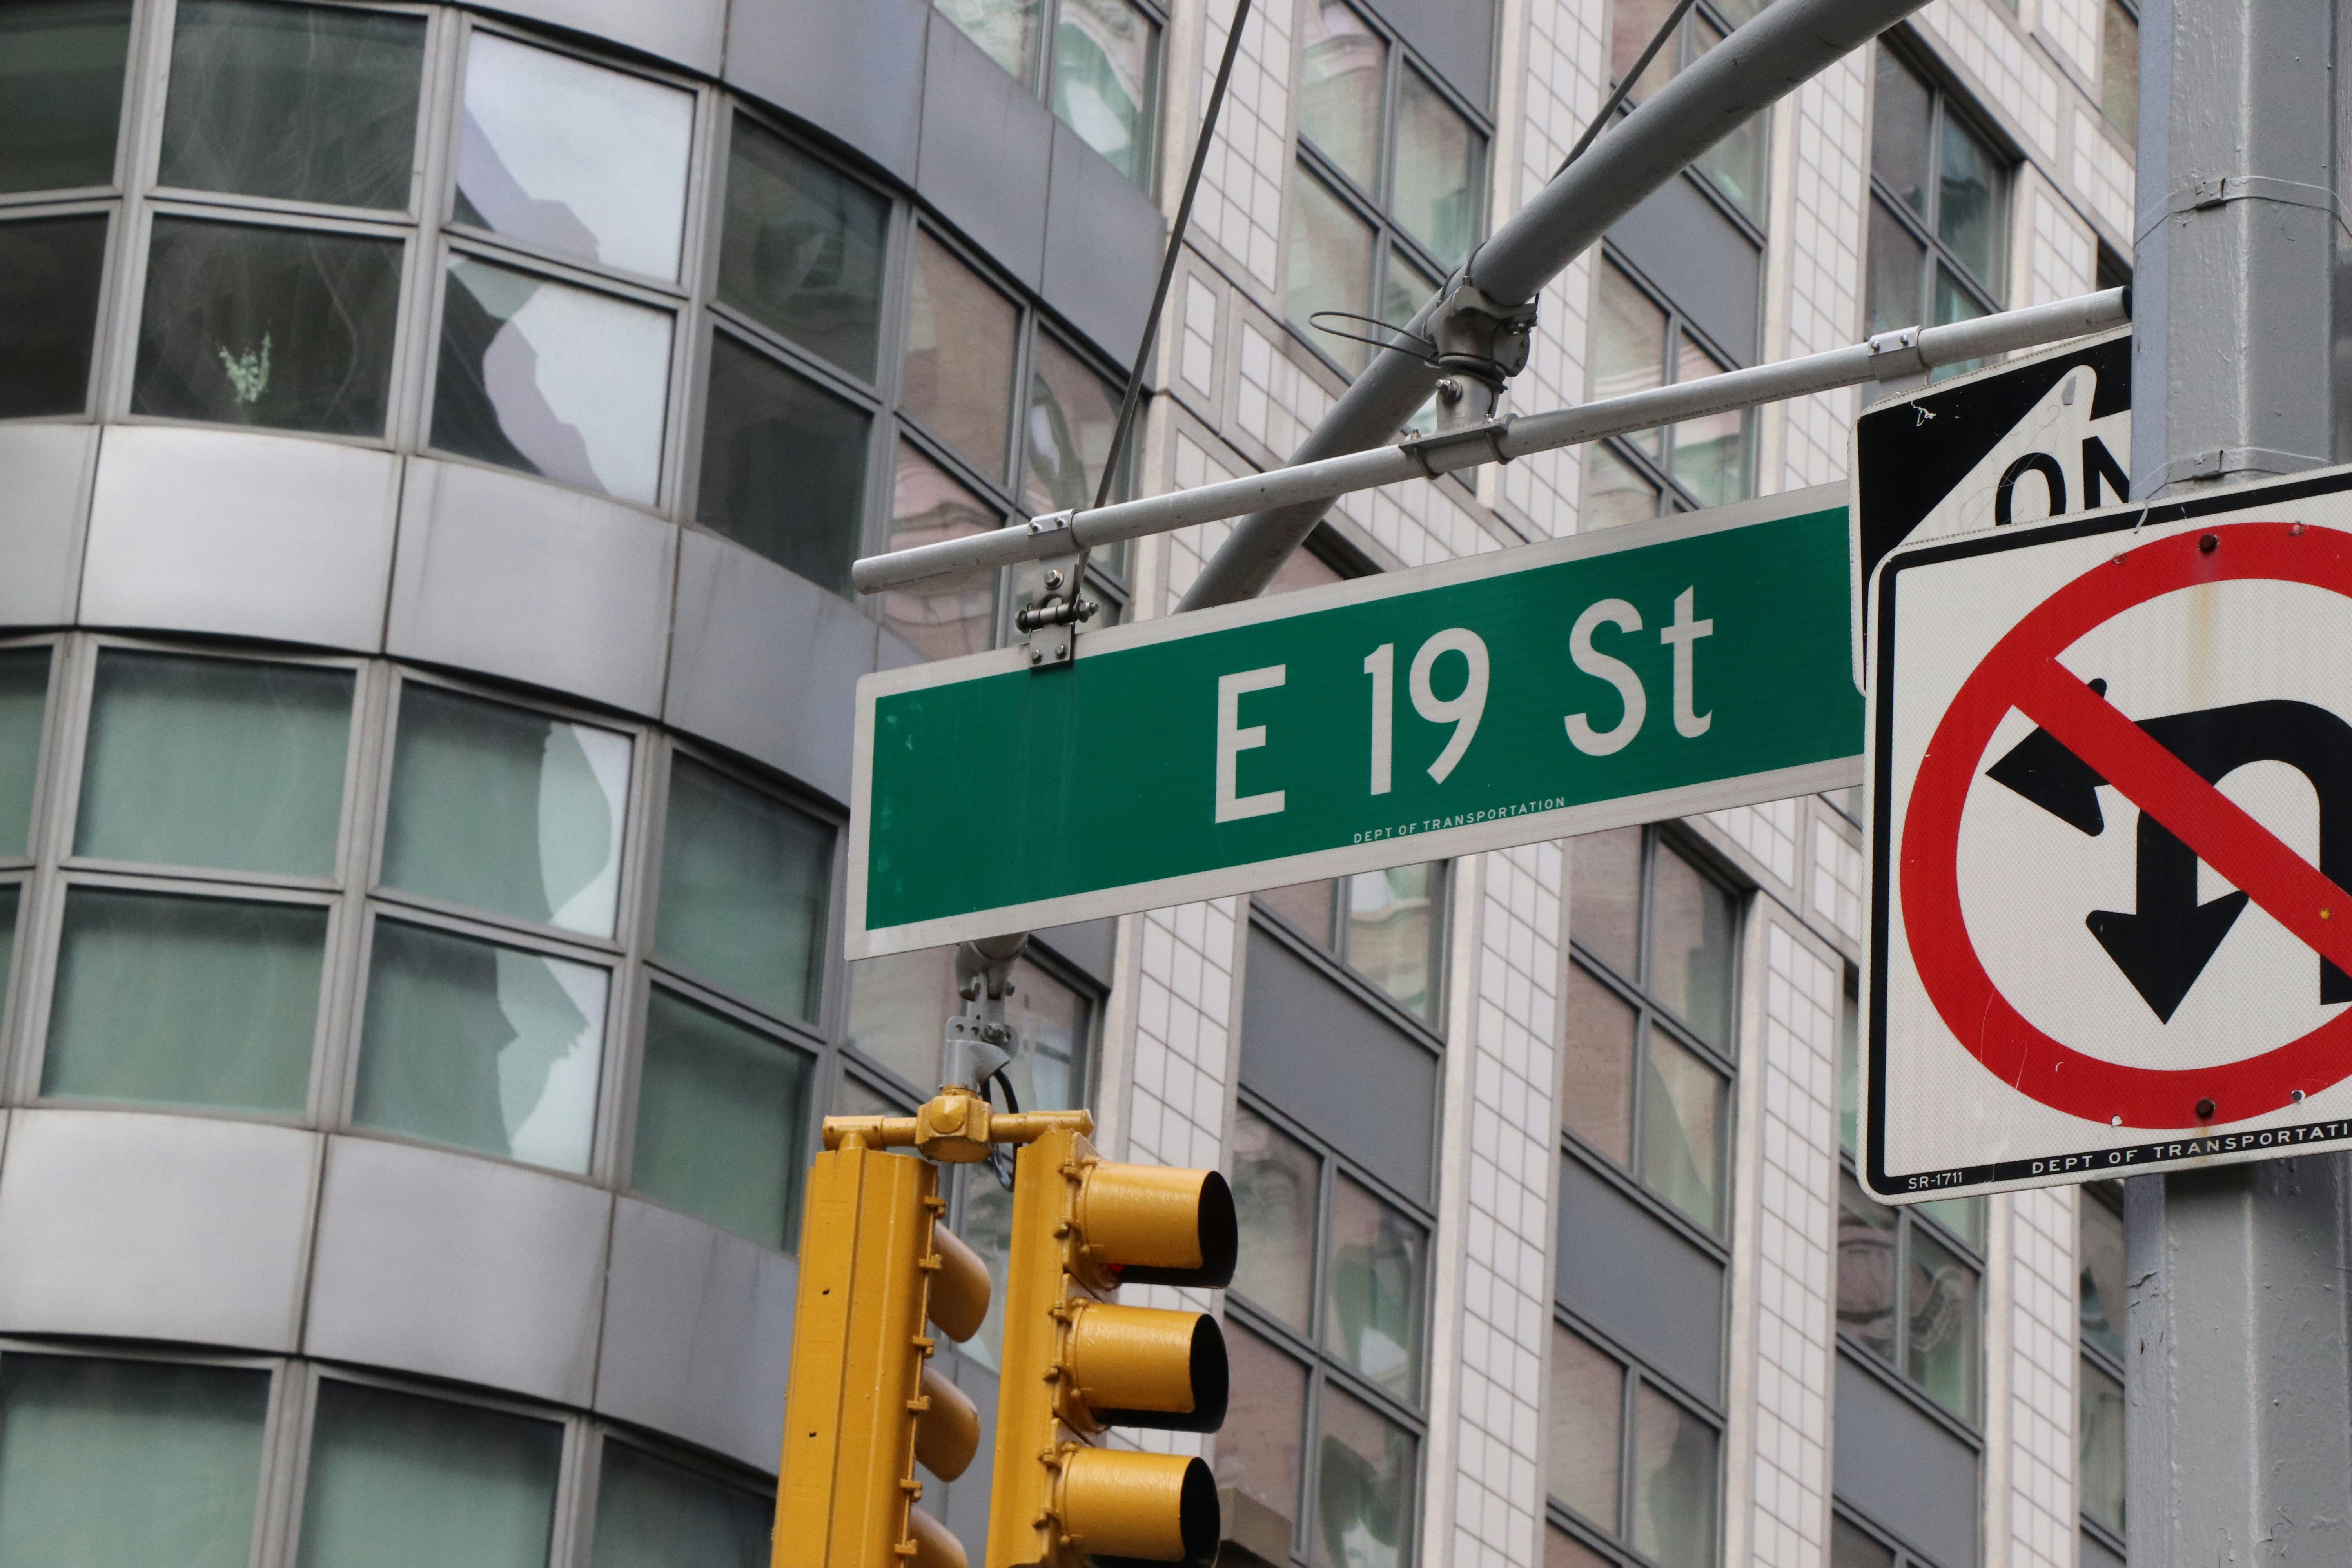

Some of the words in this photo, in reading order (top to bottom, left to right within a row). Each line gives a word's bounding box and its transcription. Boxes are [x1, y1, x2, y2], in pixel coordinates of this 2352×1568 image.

[1215, 664, 1286, 824] E
[1363, 627, 1490, 796] 19
[1564, 586, 1713, 757] St
[1354, 827, 1392, 844] DEPT
[1399, 823, 1417, 835] OF
[1423, 797, 1565, 831] TRANSPORTATION
[2032, 1155, 2092, 1174] DEPT
[2109, 1149, 2137, 1164] OF
[2153, 1123, 2348, 1158] TRANSPORTATI
[1908, 1172, 1962, 1189] SR-1711
